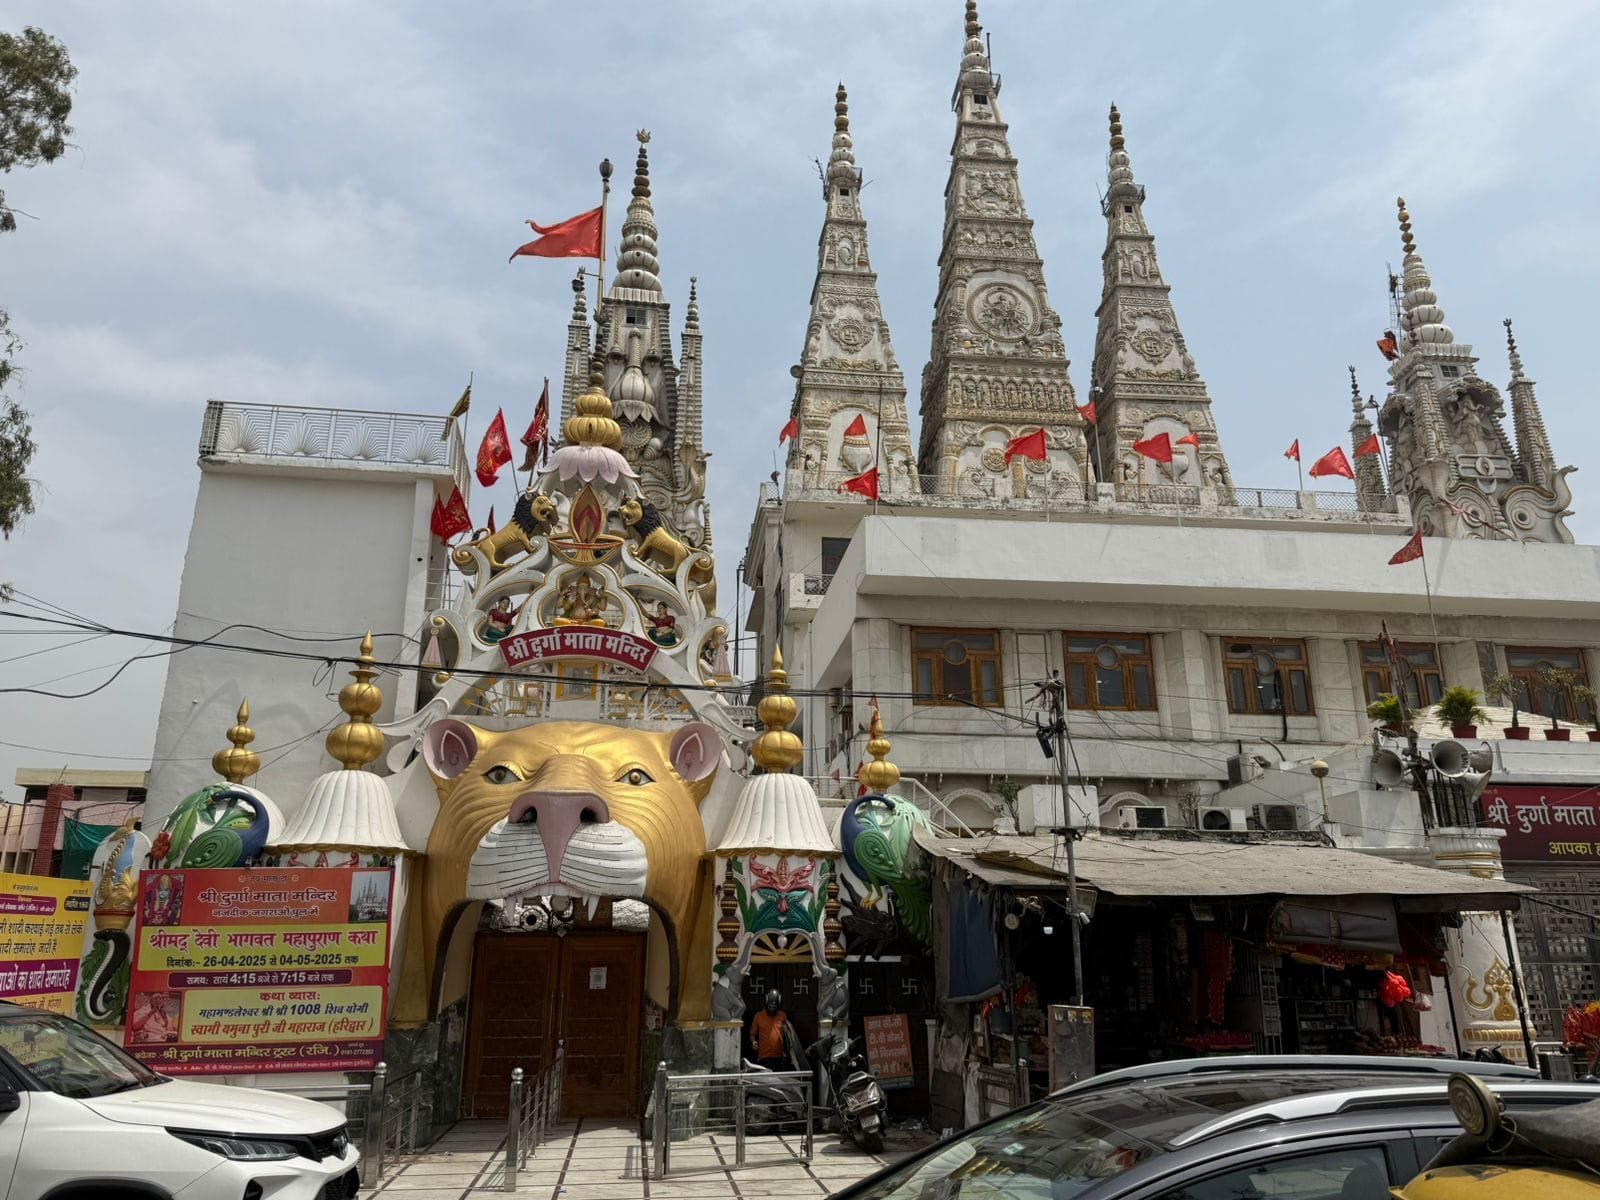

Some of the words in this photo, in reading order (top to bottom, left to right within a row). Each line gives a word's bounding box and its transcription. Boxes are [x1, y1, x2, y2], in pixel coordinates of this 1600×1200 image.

[507, 637, 529, 660] श्री
[529, 628, 562, 659] दुर्गा
[563, 632, 604, 650] माता
[607, 634, 650, 663] मन्दिर
[1488, 797, 1511, 824] श्री
[1515, 796, 1551, 833] दुर्गा
[1552, 805, 1597, 825] माता
[1549, 842, 1593, 855] आपका
[198, 888, 217, 902] श्री
[220, 887, 250, 906] दुर्गा
[253, 891, 288, 903] माता
[292, 888, 336, 901] मन्दिर
[212, 907, 249, 918] नजदीक
[9, 918, 24, 934] शादी
[191, 927, 221, 949] देवी
[226, 932, 277, 949] भागवत
[282, 931, 343, 953] महापुराण
[347, 930, 379, 946] कथा
[203, 955, 266, 967] 26-04-2025
[269, 954, 277, 966] से
[279, 953, 342, 966] 04-05-2025
[344, 955, 359, 965] तक
[19, 968, 27, 991] का
[28, 963, 46, 990] शादी
[46, 962, 71, 990] समारोह
[229, 972, 256, 984] 4:15
[257, 973, 270, 984] बजे
[271, 972, 280, 984] से
[280, 971, 306, 983] 7:15
[307, 972, 320, 983] बजे
[321, 973, 335, 983] तक
[259, 991, 285, 1001] कथा
[261, 1005, 274, 1017] श्री
[275, 1004, 288, 1016] श्री
[290, 1003, 321, 1016] 1008
[324, 1002, 343, 1014] शिव
[345, 1001, 369, 1014] योगी
[190, 1020, 221, 1036] स्वामी
[222, 1023, 250, 1039] यमुना
[252, 1020, 272, 1039] पुरी
[272, 1019, 286, 1034] जी
[287, 1021, 326, 1036] महाराज
[163, 1046, 178, 1059] श्री
[178, 1046, 202, 1062] दुर्गा
[203, 1048, 233, 1059] माता
[234, 1045, 271, 1058] मन्दिर
[273, 1047, 296, 1059] ट्रस्ट
